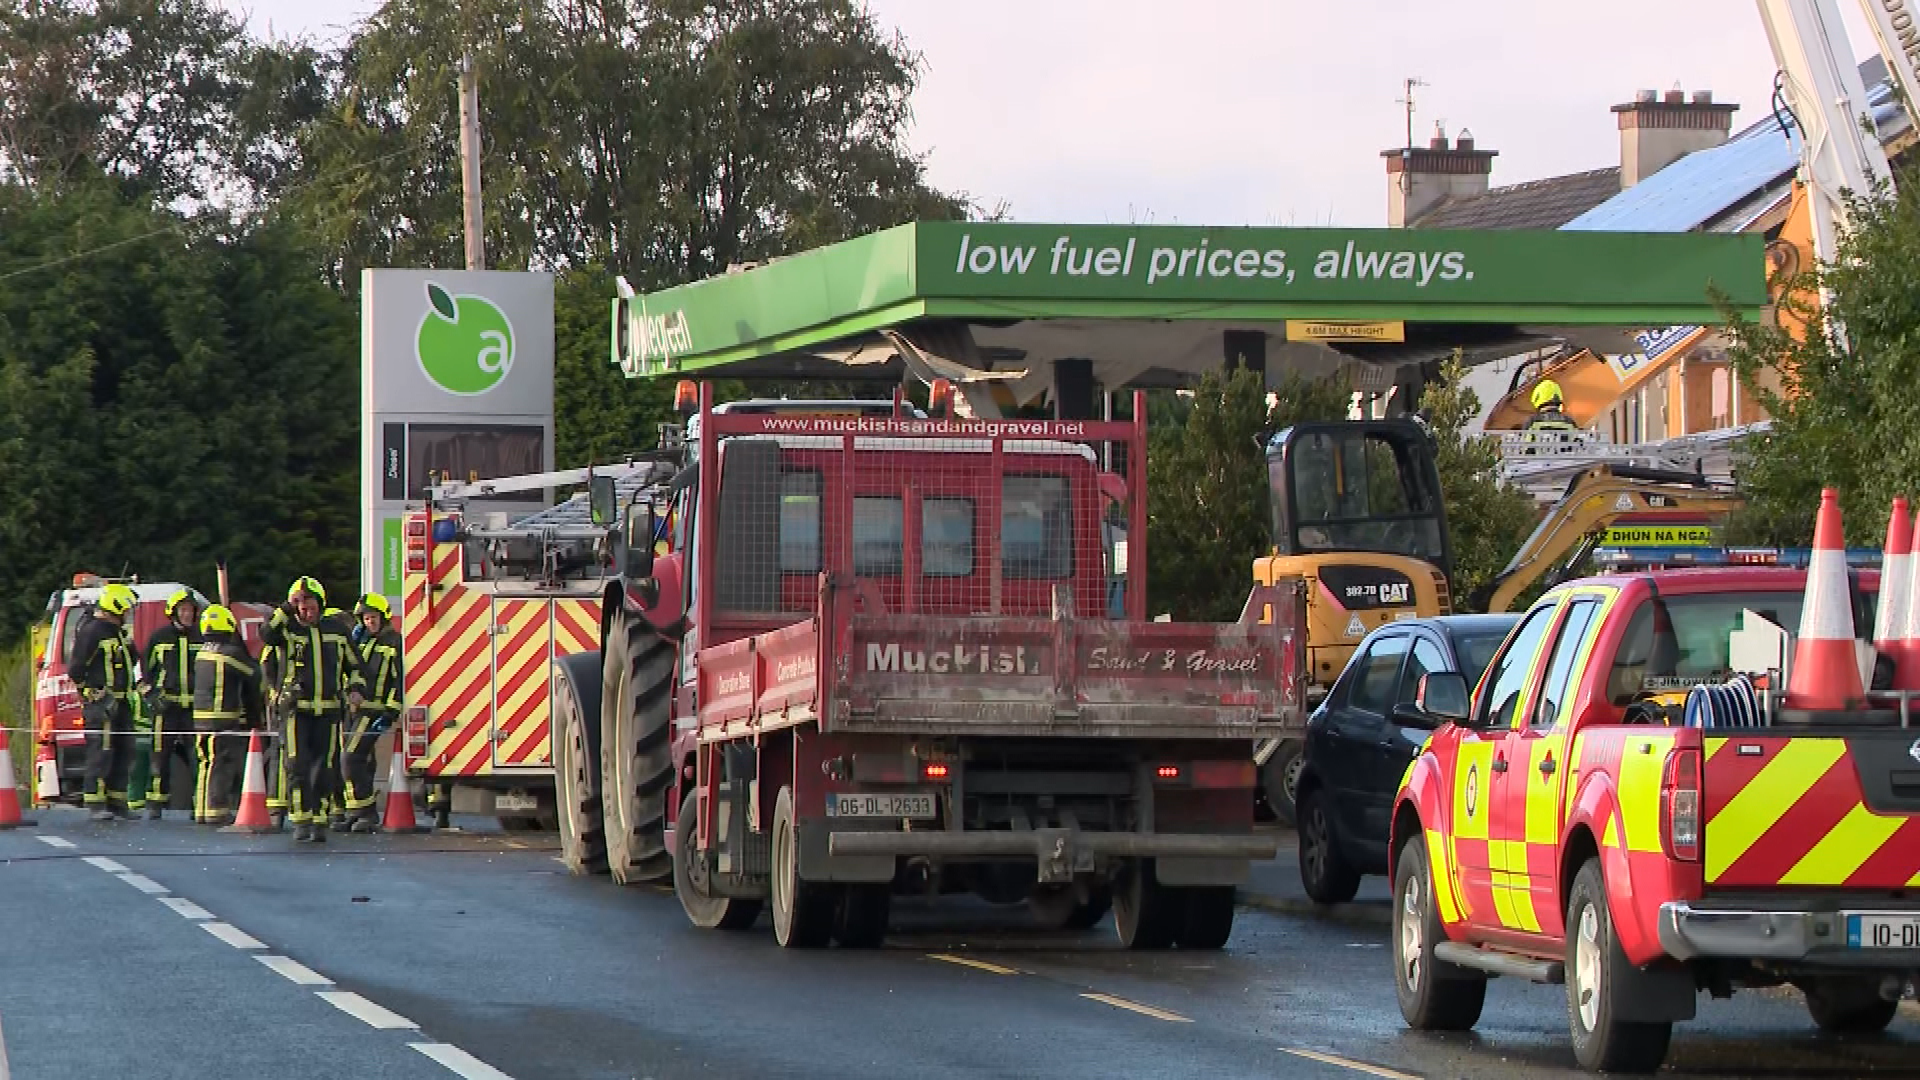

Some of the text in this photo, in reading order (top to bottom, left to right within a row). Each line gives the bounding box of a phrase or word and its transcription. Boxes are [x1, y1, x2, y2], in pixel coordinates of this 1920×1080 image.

[955, 234, 1476, 287] low fuel prices, always.
[1328, 326, 1348, 336] MAX
[1350, 326, 1385, 336] HEIGHT
[762, 416, 1084, 437] www.muckishsandandgravel.net
[1655, 531, 1674, 541] NA
[1380, 583, 1409, 603] CAT
[840, 797, 930, 815] 06-DL-12633
